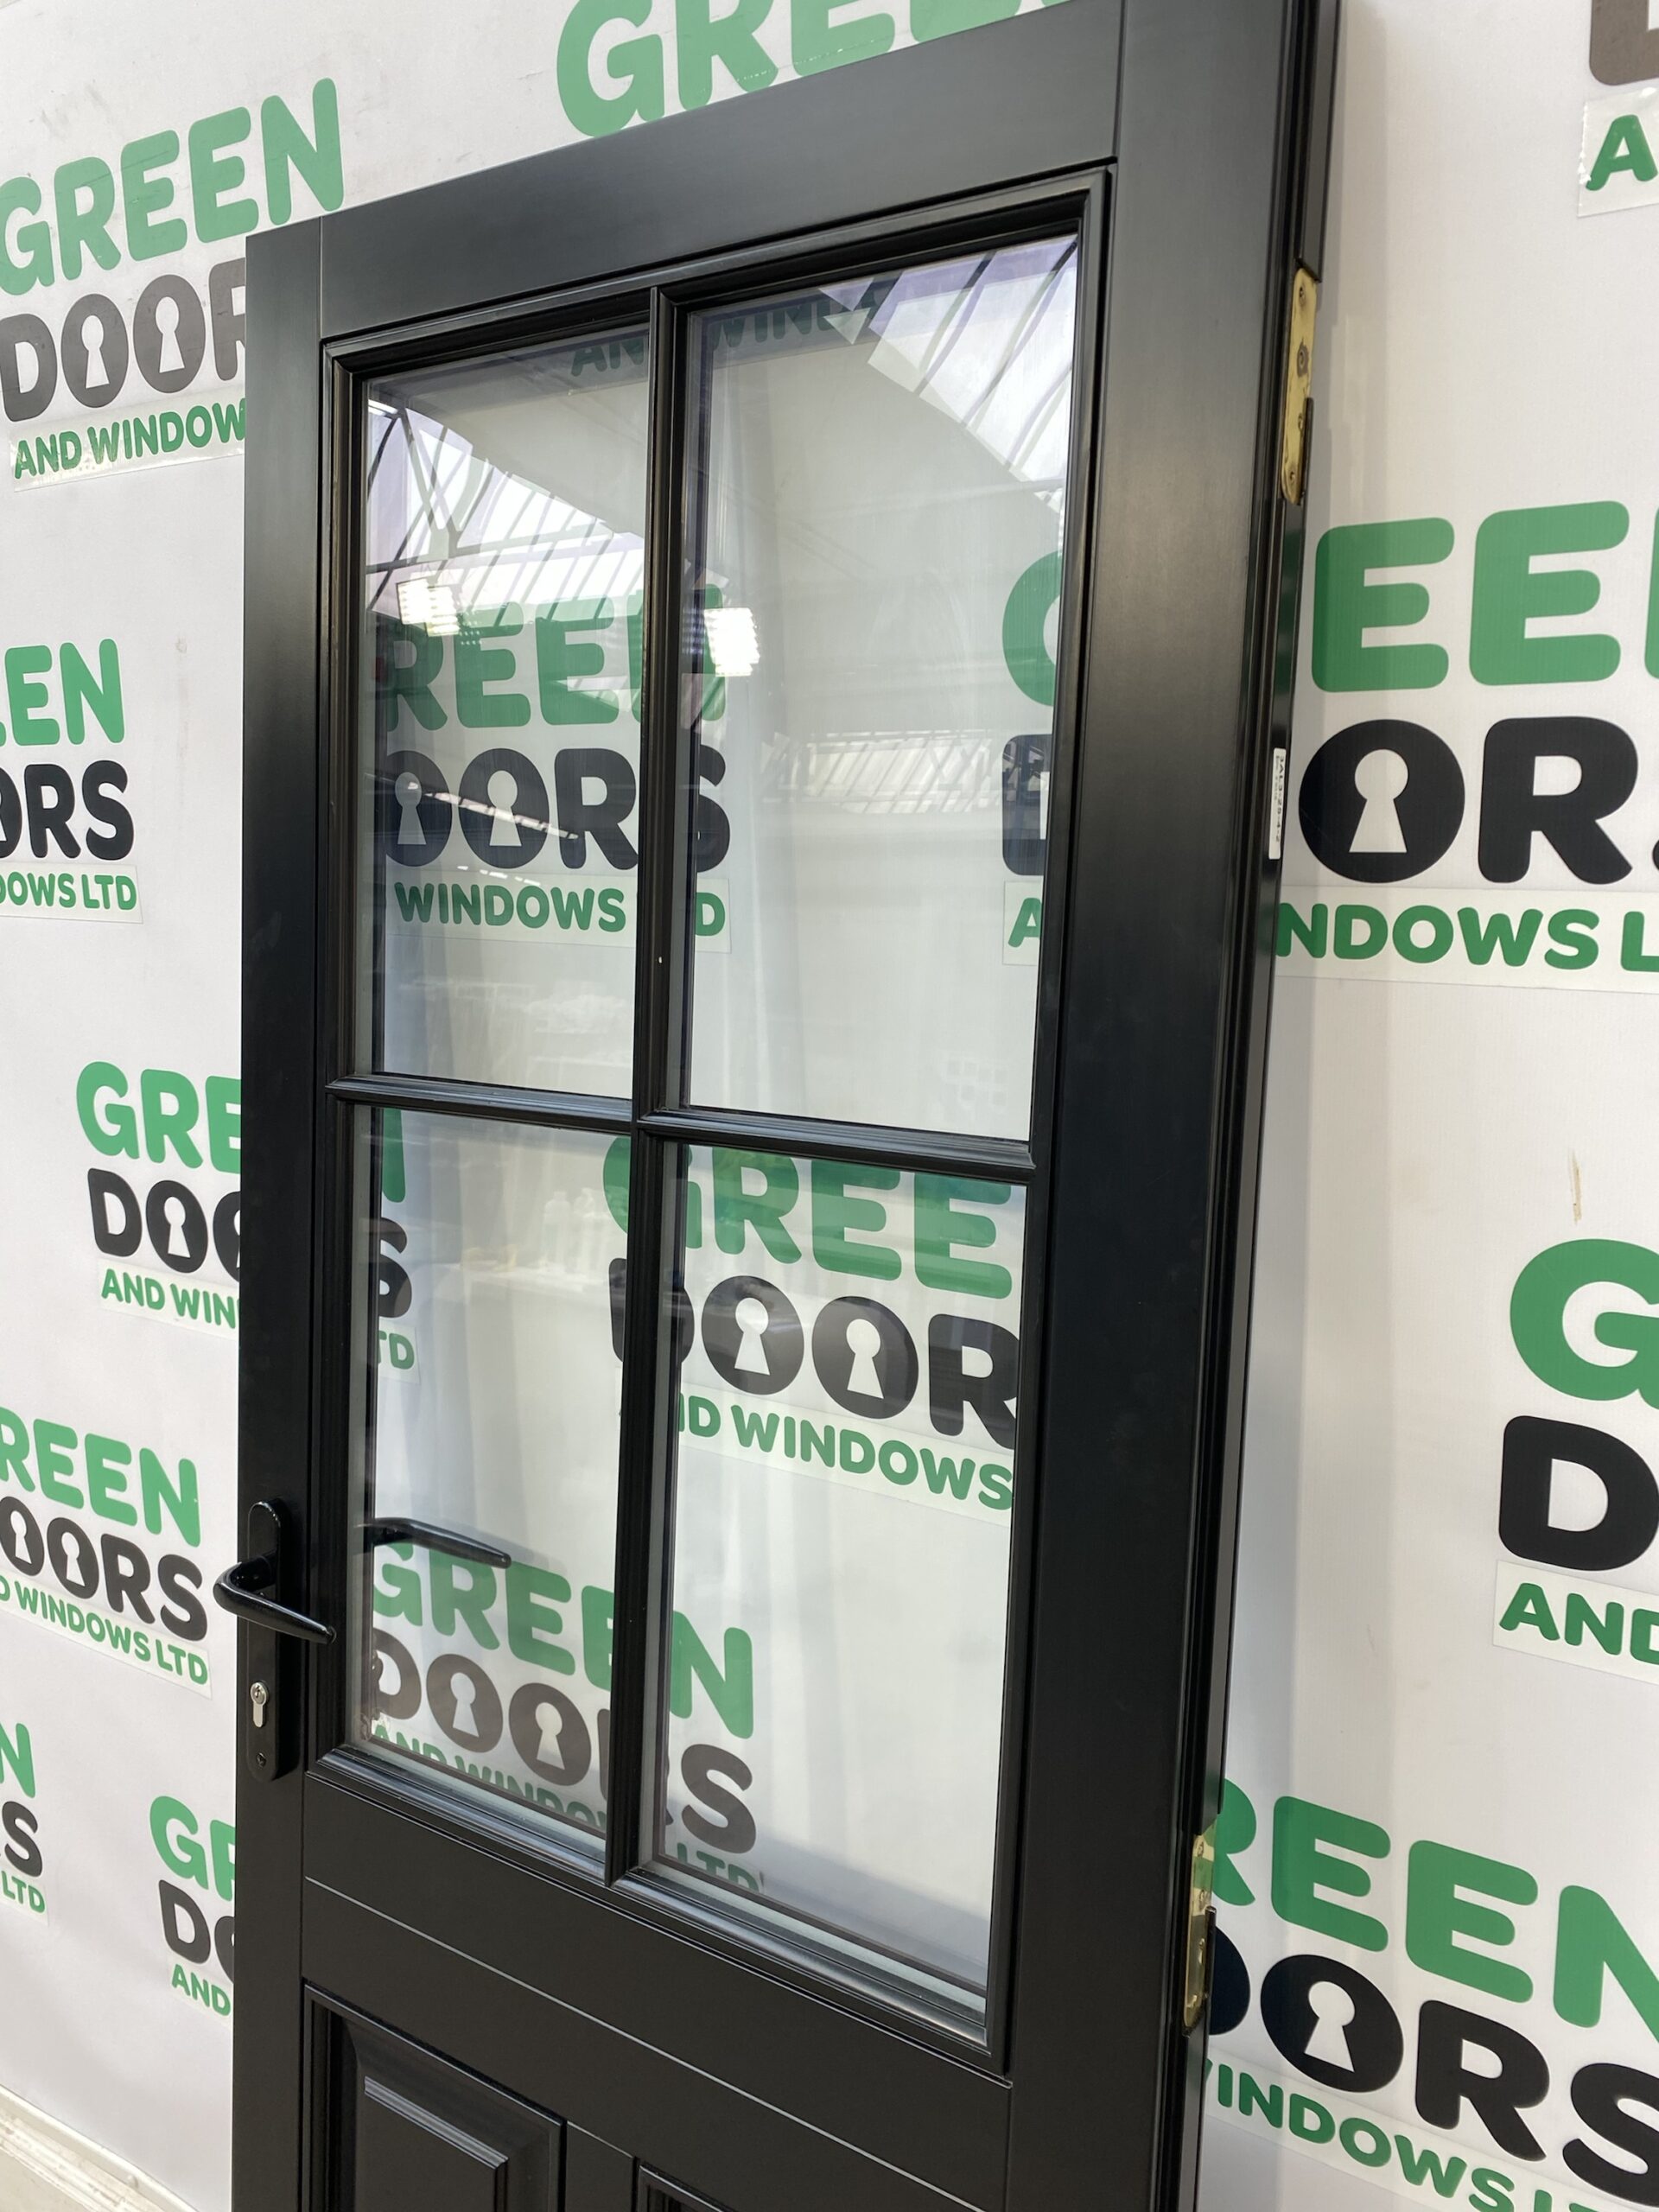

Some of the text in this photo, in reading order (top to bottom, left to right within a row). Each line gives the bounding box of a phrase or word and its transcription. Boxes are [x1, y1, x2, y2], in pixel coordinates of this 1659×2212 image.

[0, 78, 344, 296] GREEN
[571, 337, 645, 377] AN
[14, 429, 83, 480] AND
[1312, 500, 1659, 693] EE
[0, 639, 125, 747] EN
[1299, 717, 1659, 885] OR
[0, 872, 137, 911] OWS LTD
[394, 881, 626, 932] WINDOWS
[101, 1268, 239, 1329] AND WIN
[731, 1405, 1014, 1511] WINDOWS
[15, 1580, 150, 1662] WINDOWS
[156, 1639, 208, 1685] LTD
[372, 1627, 756, 1854] DOOS
[1, 1871, 46, 1914] LTD
[172, 1964, 231, 2016] AND
[1210, 1926, 1659, 2208] ORS
[1206, 2059, 1515, 2212] INDOWS
